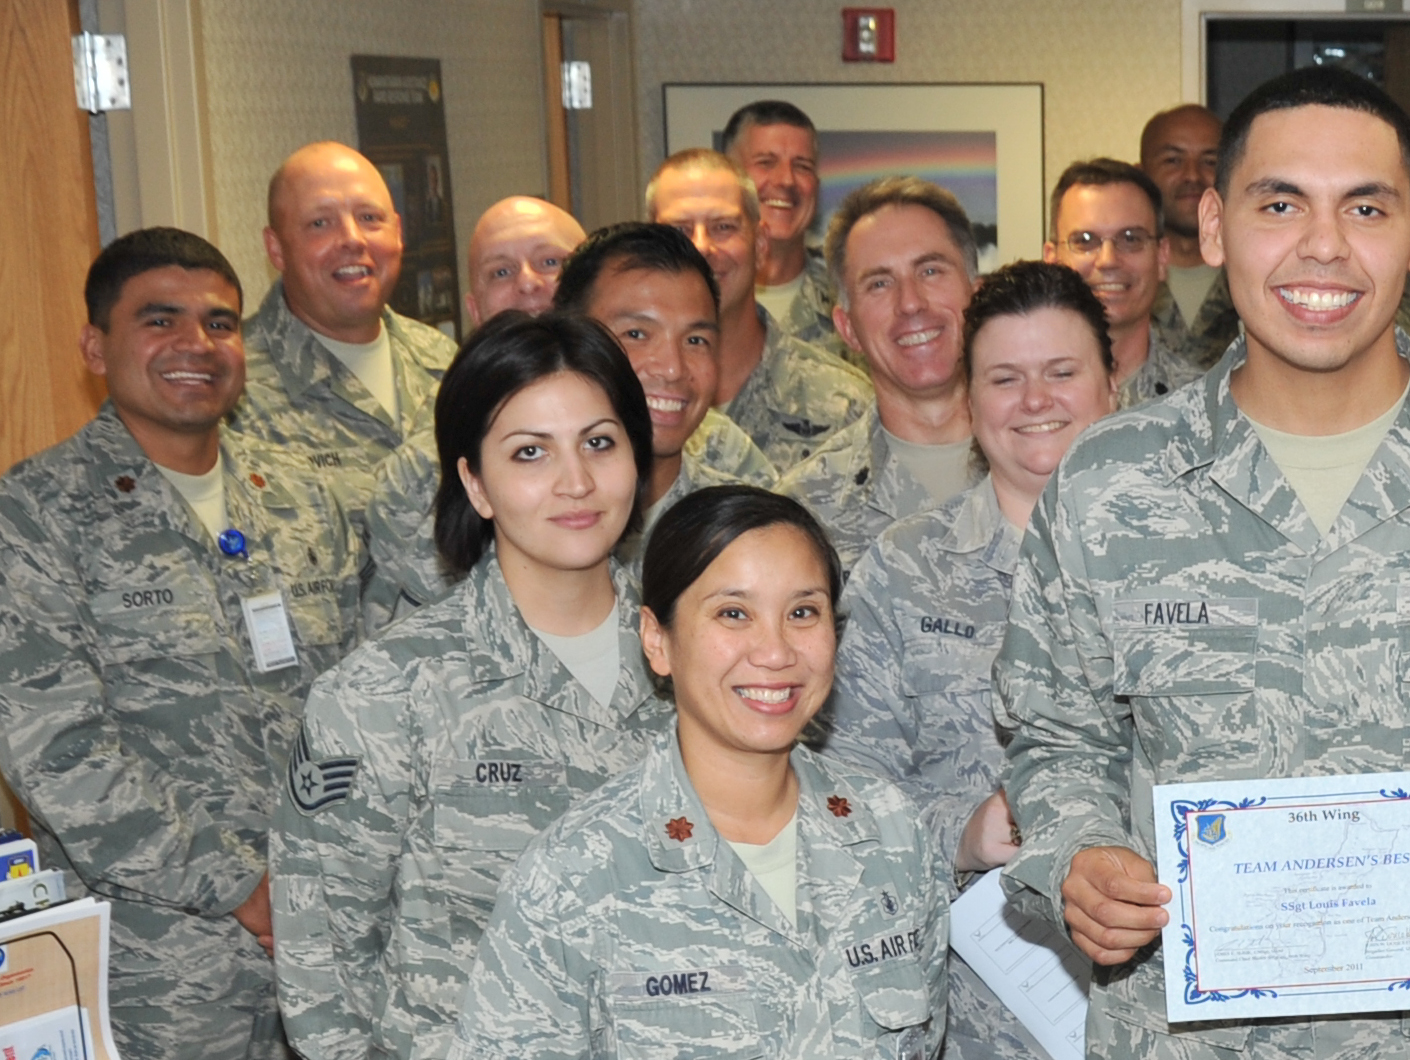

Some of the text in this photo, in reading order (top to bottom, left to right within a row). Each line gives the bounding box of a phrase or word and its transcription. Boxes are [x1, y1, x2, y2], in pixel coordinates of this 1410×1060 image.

[122, 588, 173, 608] SORTO
[1144, 602, 1209, 625] FAVELA
[920, 615, 975, 639] GALLO
[476, 762, 523, 783] CRUZ
[1288, 809, 1360, 823] 36th Wing
[1234, 861, 1277, 874] TEAM
[1281, 855, 1378, 871] ANDERSEN'S
[1280, 897, 1376, 913] SSgt Louis Favela
[846, 944, 878, 967] U.S.
[881, 935, 907, 960] AIR
[1304, 963, 1363, 974] September 2011
[646, 971, 712, 997] GOMEZ
